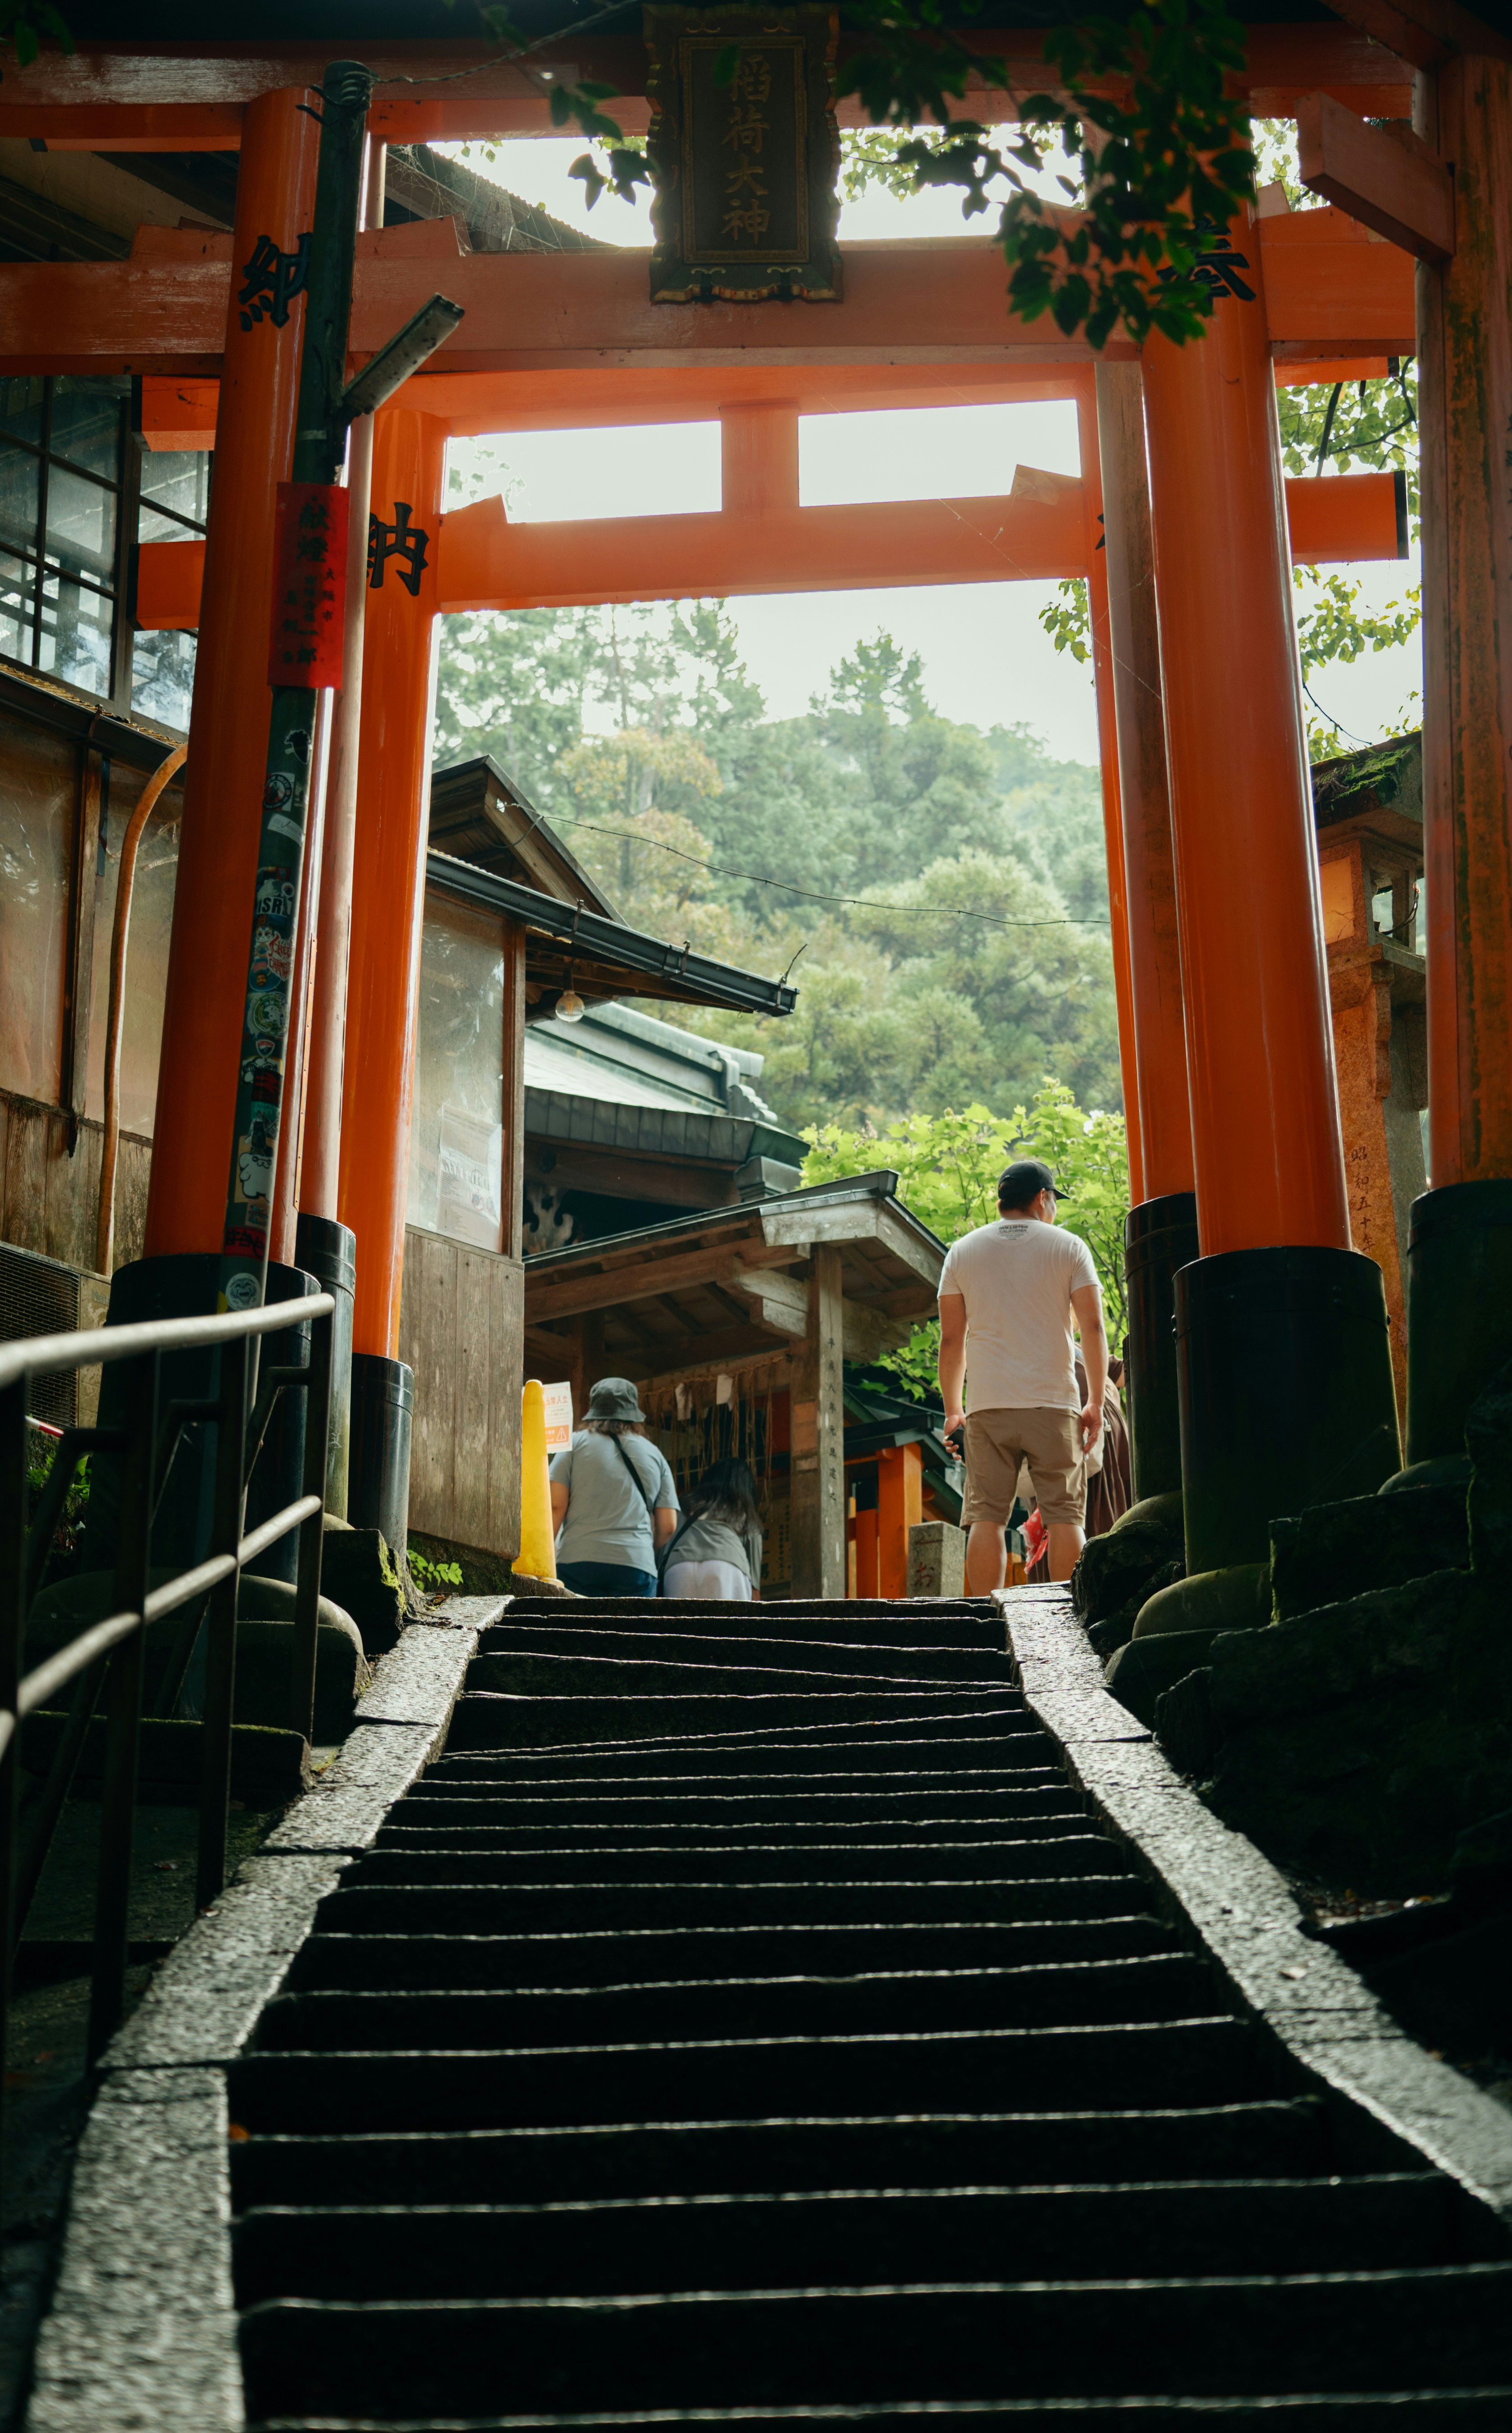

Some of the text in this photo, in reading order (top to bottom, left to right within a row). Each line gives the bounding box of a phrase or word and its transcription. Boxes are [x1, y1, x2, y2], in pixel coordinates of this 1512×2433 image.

[1351, 1146, 1375, 1251] 昭和五十年
[914, 1561, 934, 1587] お
